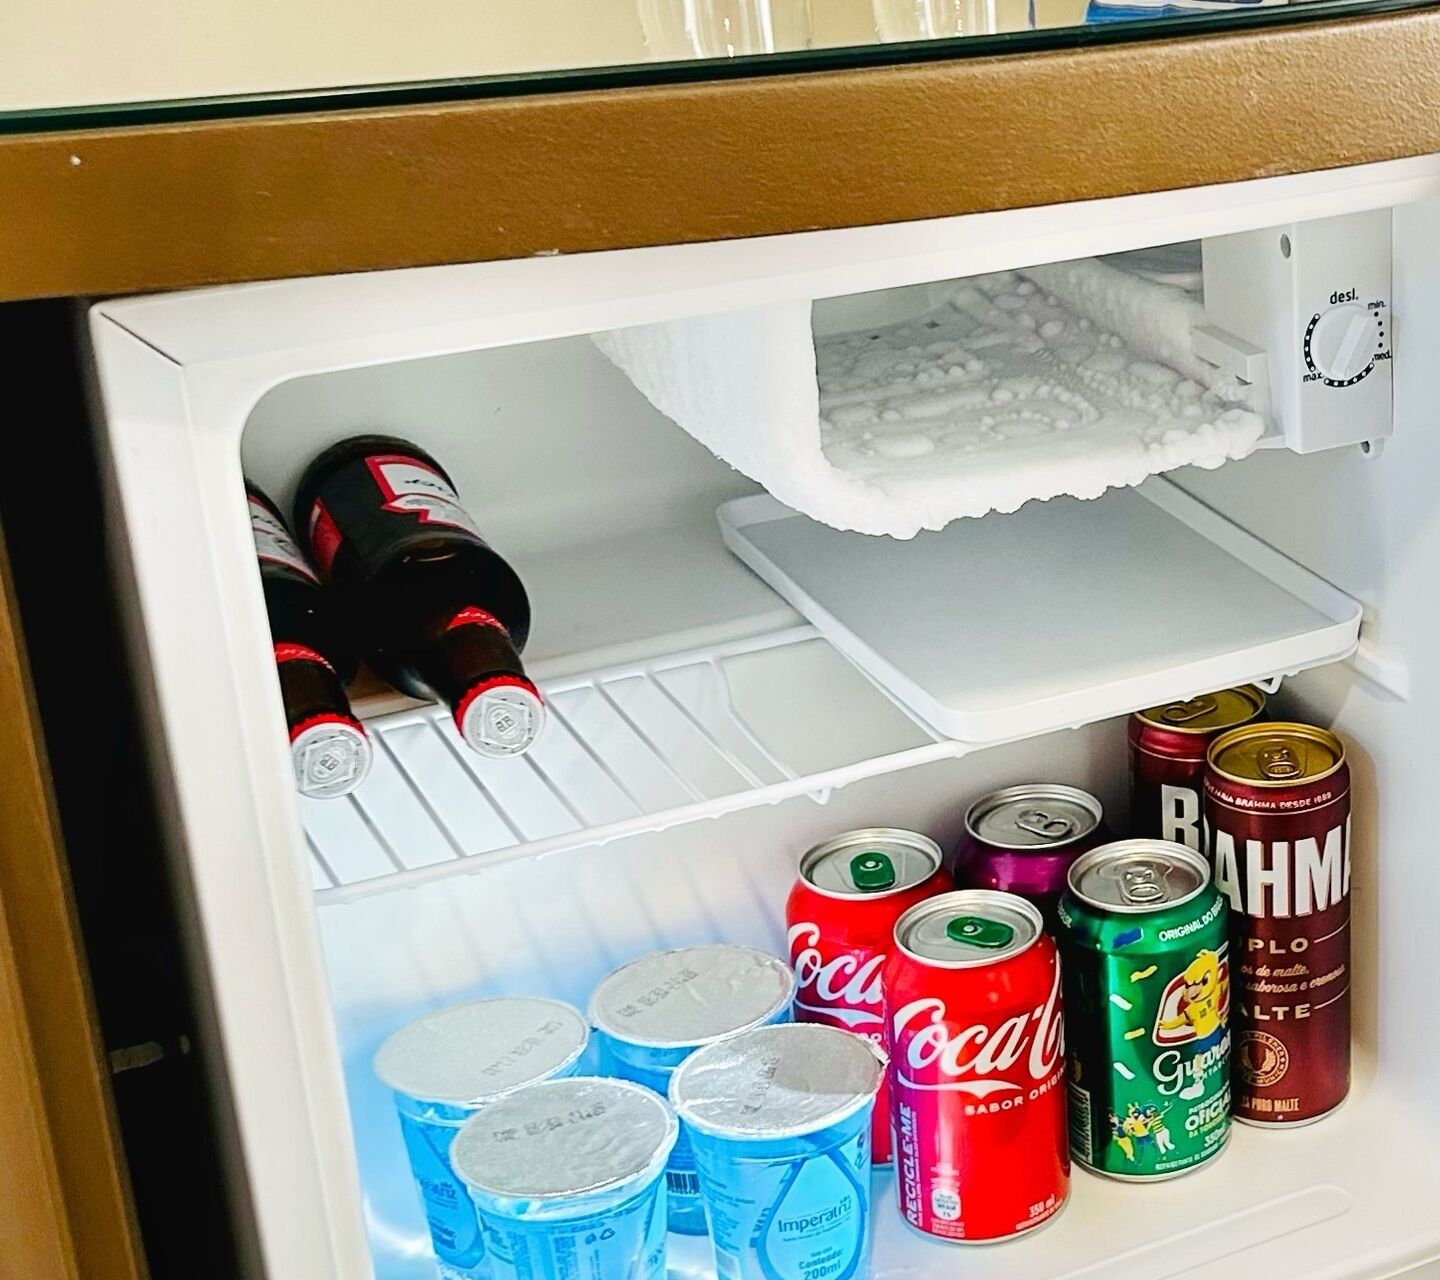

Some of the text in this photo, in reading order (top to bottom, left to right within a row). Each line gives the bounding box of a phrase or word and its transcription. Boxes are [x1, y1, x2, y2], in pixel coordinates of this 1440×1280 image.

[1329, 288, 1359, 304] desl.
[1235, 797, 1277, 809] BRAHMA
[1204, 813, 1350, 919] AHM
[1158, 917, 1205, 942] ORIGINAL
[1247, 937, 1309, 955] PLO
[964, 1095, 1023, 1116] SABOR
[1252, 1096, 1300, 1112] PURO MALTE
[900, 1102, 918, 1226] RECICLE-ME
[777, 1194, 853, 1234] Imperatriz
[1028, 1199, 1045, 1219] 350
